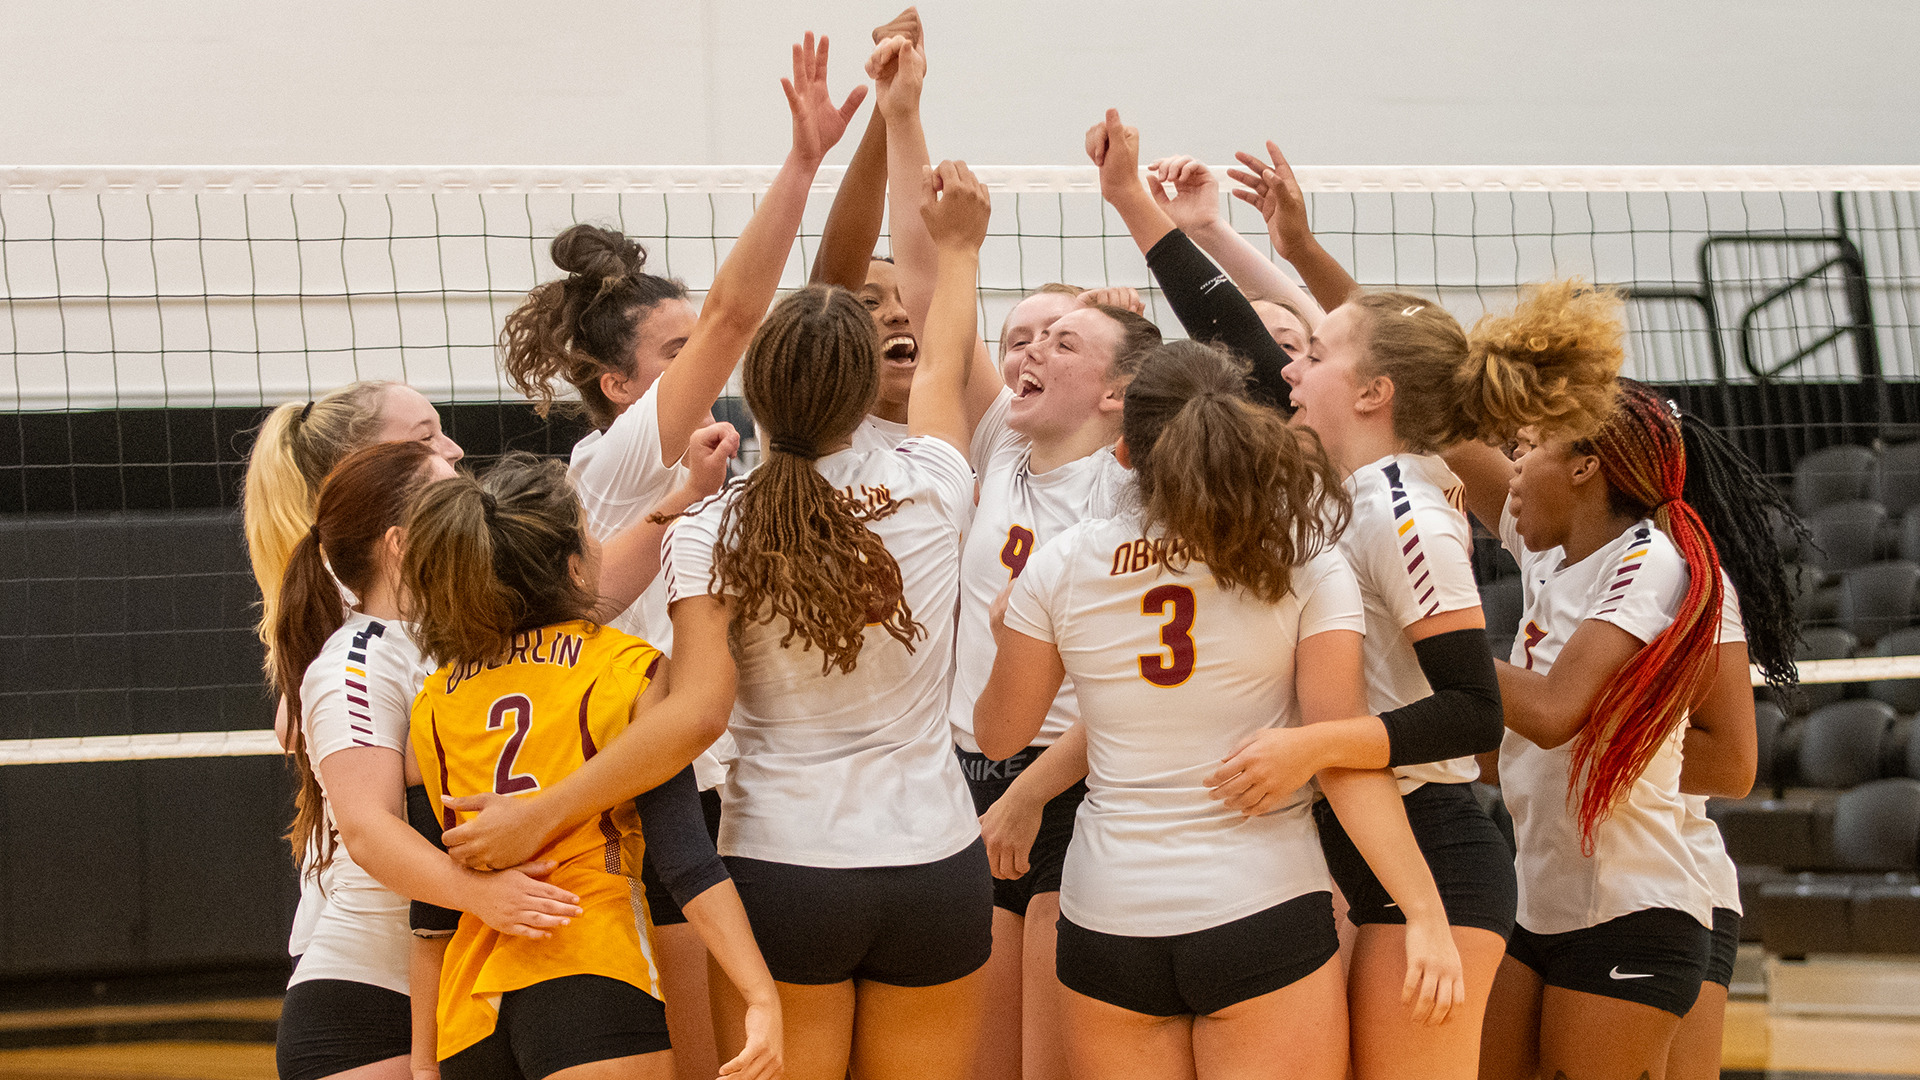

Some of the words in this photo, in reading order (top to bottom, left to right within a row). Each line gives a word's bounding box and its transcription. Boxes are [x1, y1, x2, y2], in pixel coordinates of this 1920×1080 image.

[1138, 583, 1197, 689] 3
[486, 693, 541, 796] 2
[961, 753, 1028, 781] NIKE
